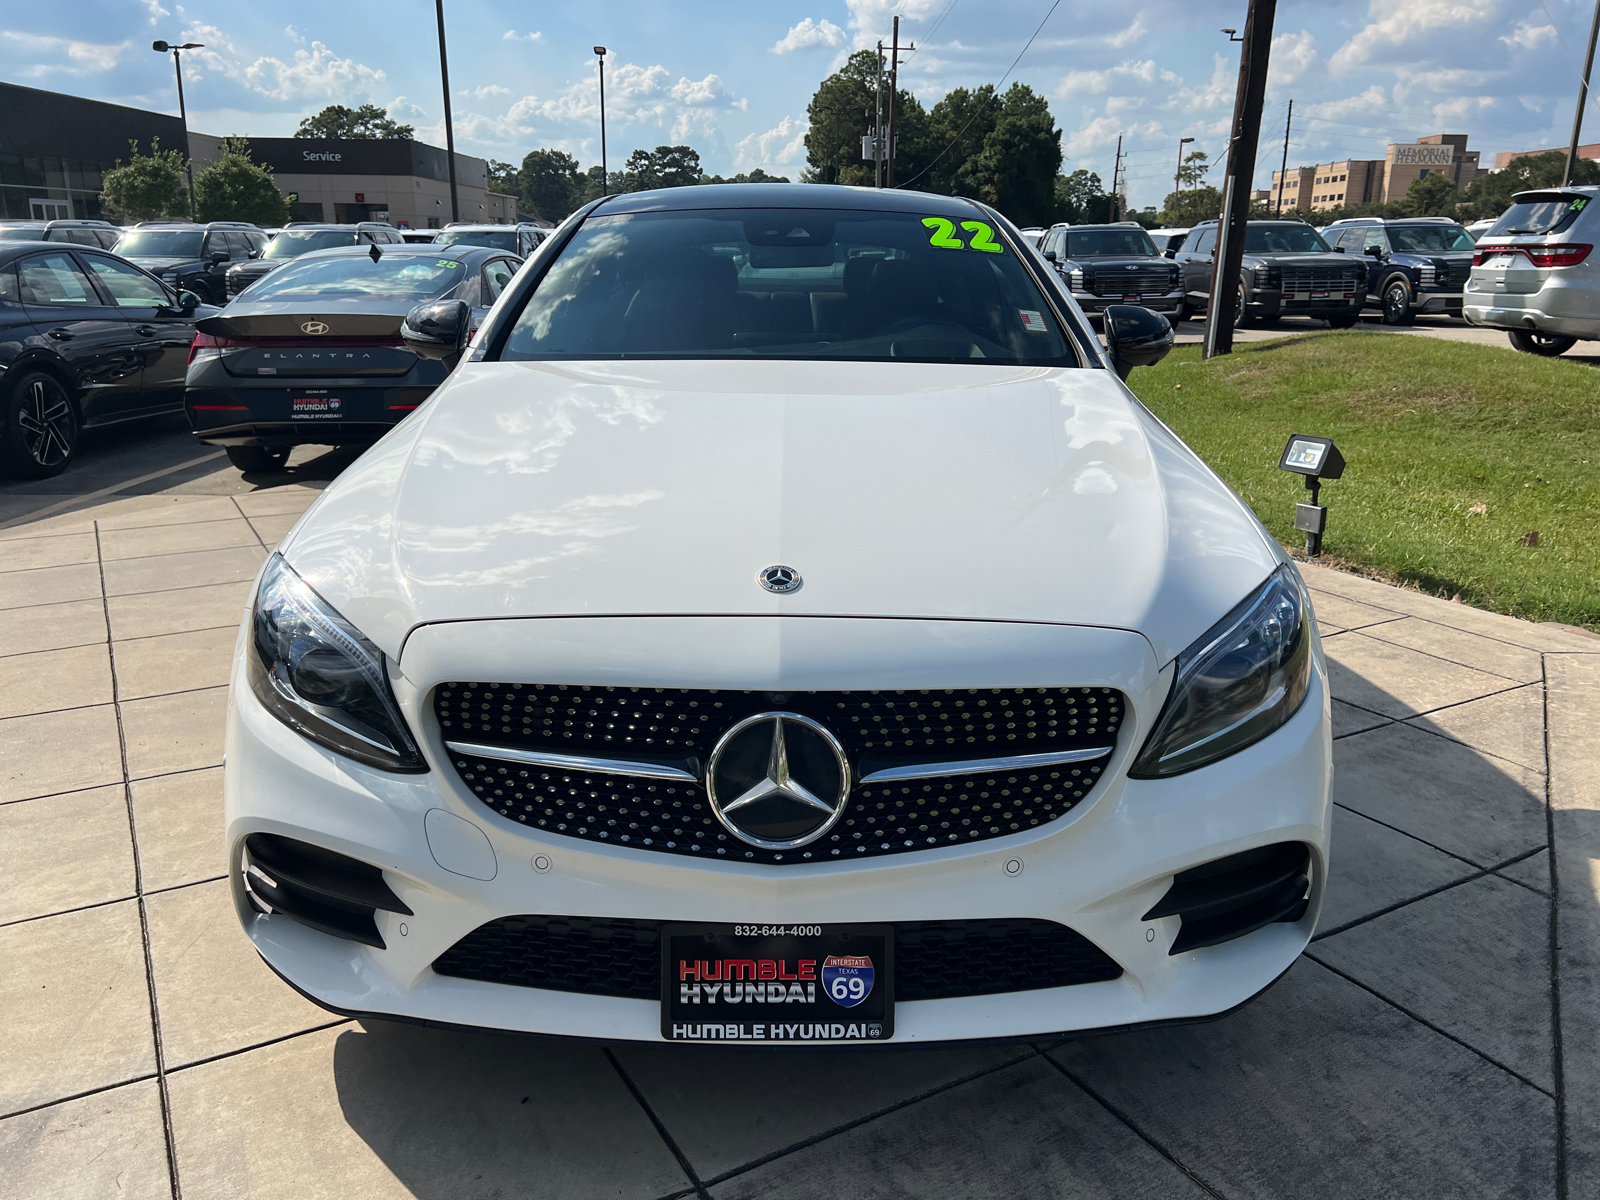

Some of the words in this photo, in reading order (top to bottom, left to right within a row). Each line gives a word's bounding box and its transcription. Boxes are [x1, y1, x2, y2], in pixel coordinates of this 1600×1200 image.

[303, 151, 341, 161] Service
[1398, 148, 1450, 157] MEMORIAL
[1395, 155, 1450, 164] HERMANN
[1569, 199, 1586, 210] 24
[921, 217, 1004, 254] 22
[435, 260, 459, 269] 25
[293, 403, 328, 411] HYUNDAI
[734, 925, 822, 937] 832-644-4000
[830, 958, 866, 967] INTERSTATE
[679, 959, 817, 981] HUMBLE
[680, 982, 816, 1004] HYUNDAI
[831, 976, 865, 1000] 69
[672, 1023, 766, 1039] HUMBLE
[770, 1023, 867, 1039] HYUNDAI
